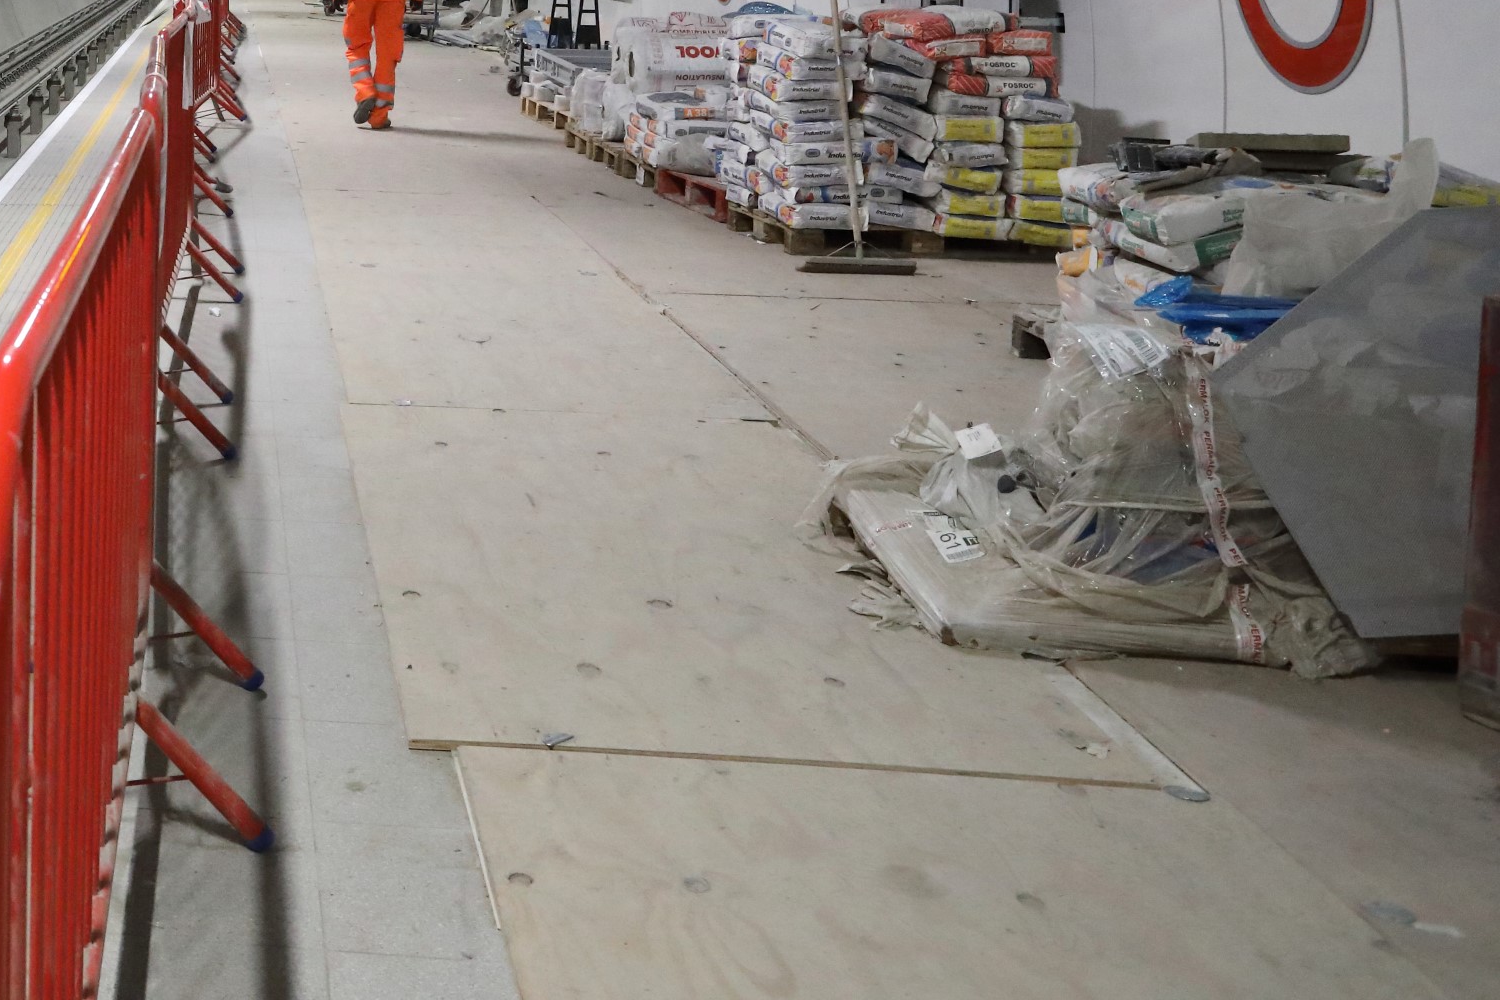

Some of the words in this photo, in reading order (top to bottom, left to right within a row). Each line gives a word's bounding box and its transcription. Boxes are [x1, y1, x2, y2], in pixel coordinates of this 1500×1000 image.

[885, 171, 912, 182] Industrial
[876, 209, 903, 218] Industrial
[1213, 487, 1230, 542] PERMALOK
